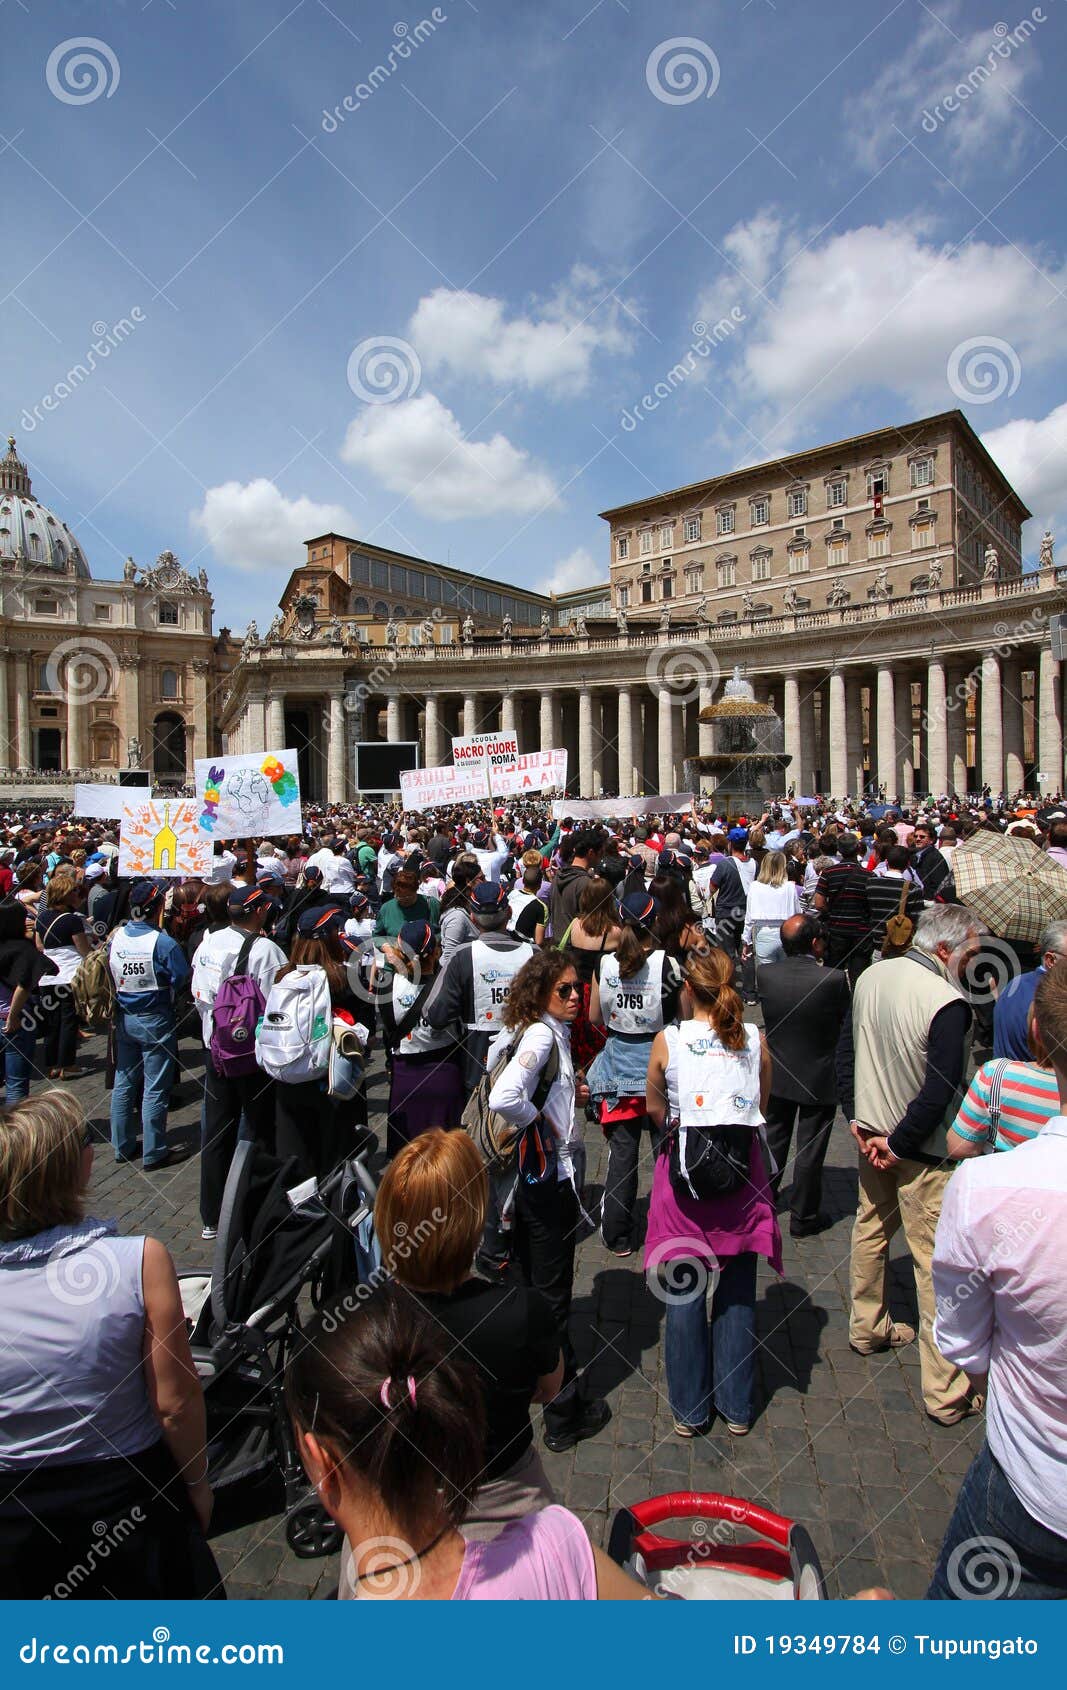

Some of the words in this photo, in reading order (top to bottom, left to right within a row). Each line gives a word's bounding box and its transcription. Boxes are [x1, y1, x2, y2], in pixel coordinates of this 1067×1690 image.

[471, 735, 498, 743] SCUOLA
[453, 745, 485, 759] SACRO
[486, 740, 517, 755] CUORE
[491, 753, 517, 765] ROMA
[122, 962, 146, 976] 2555
[616, 993, 644, 1010] 3769
